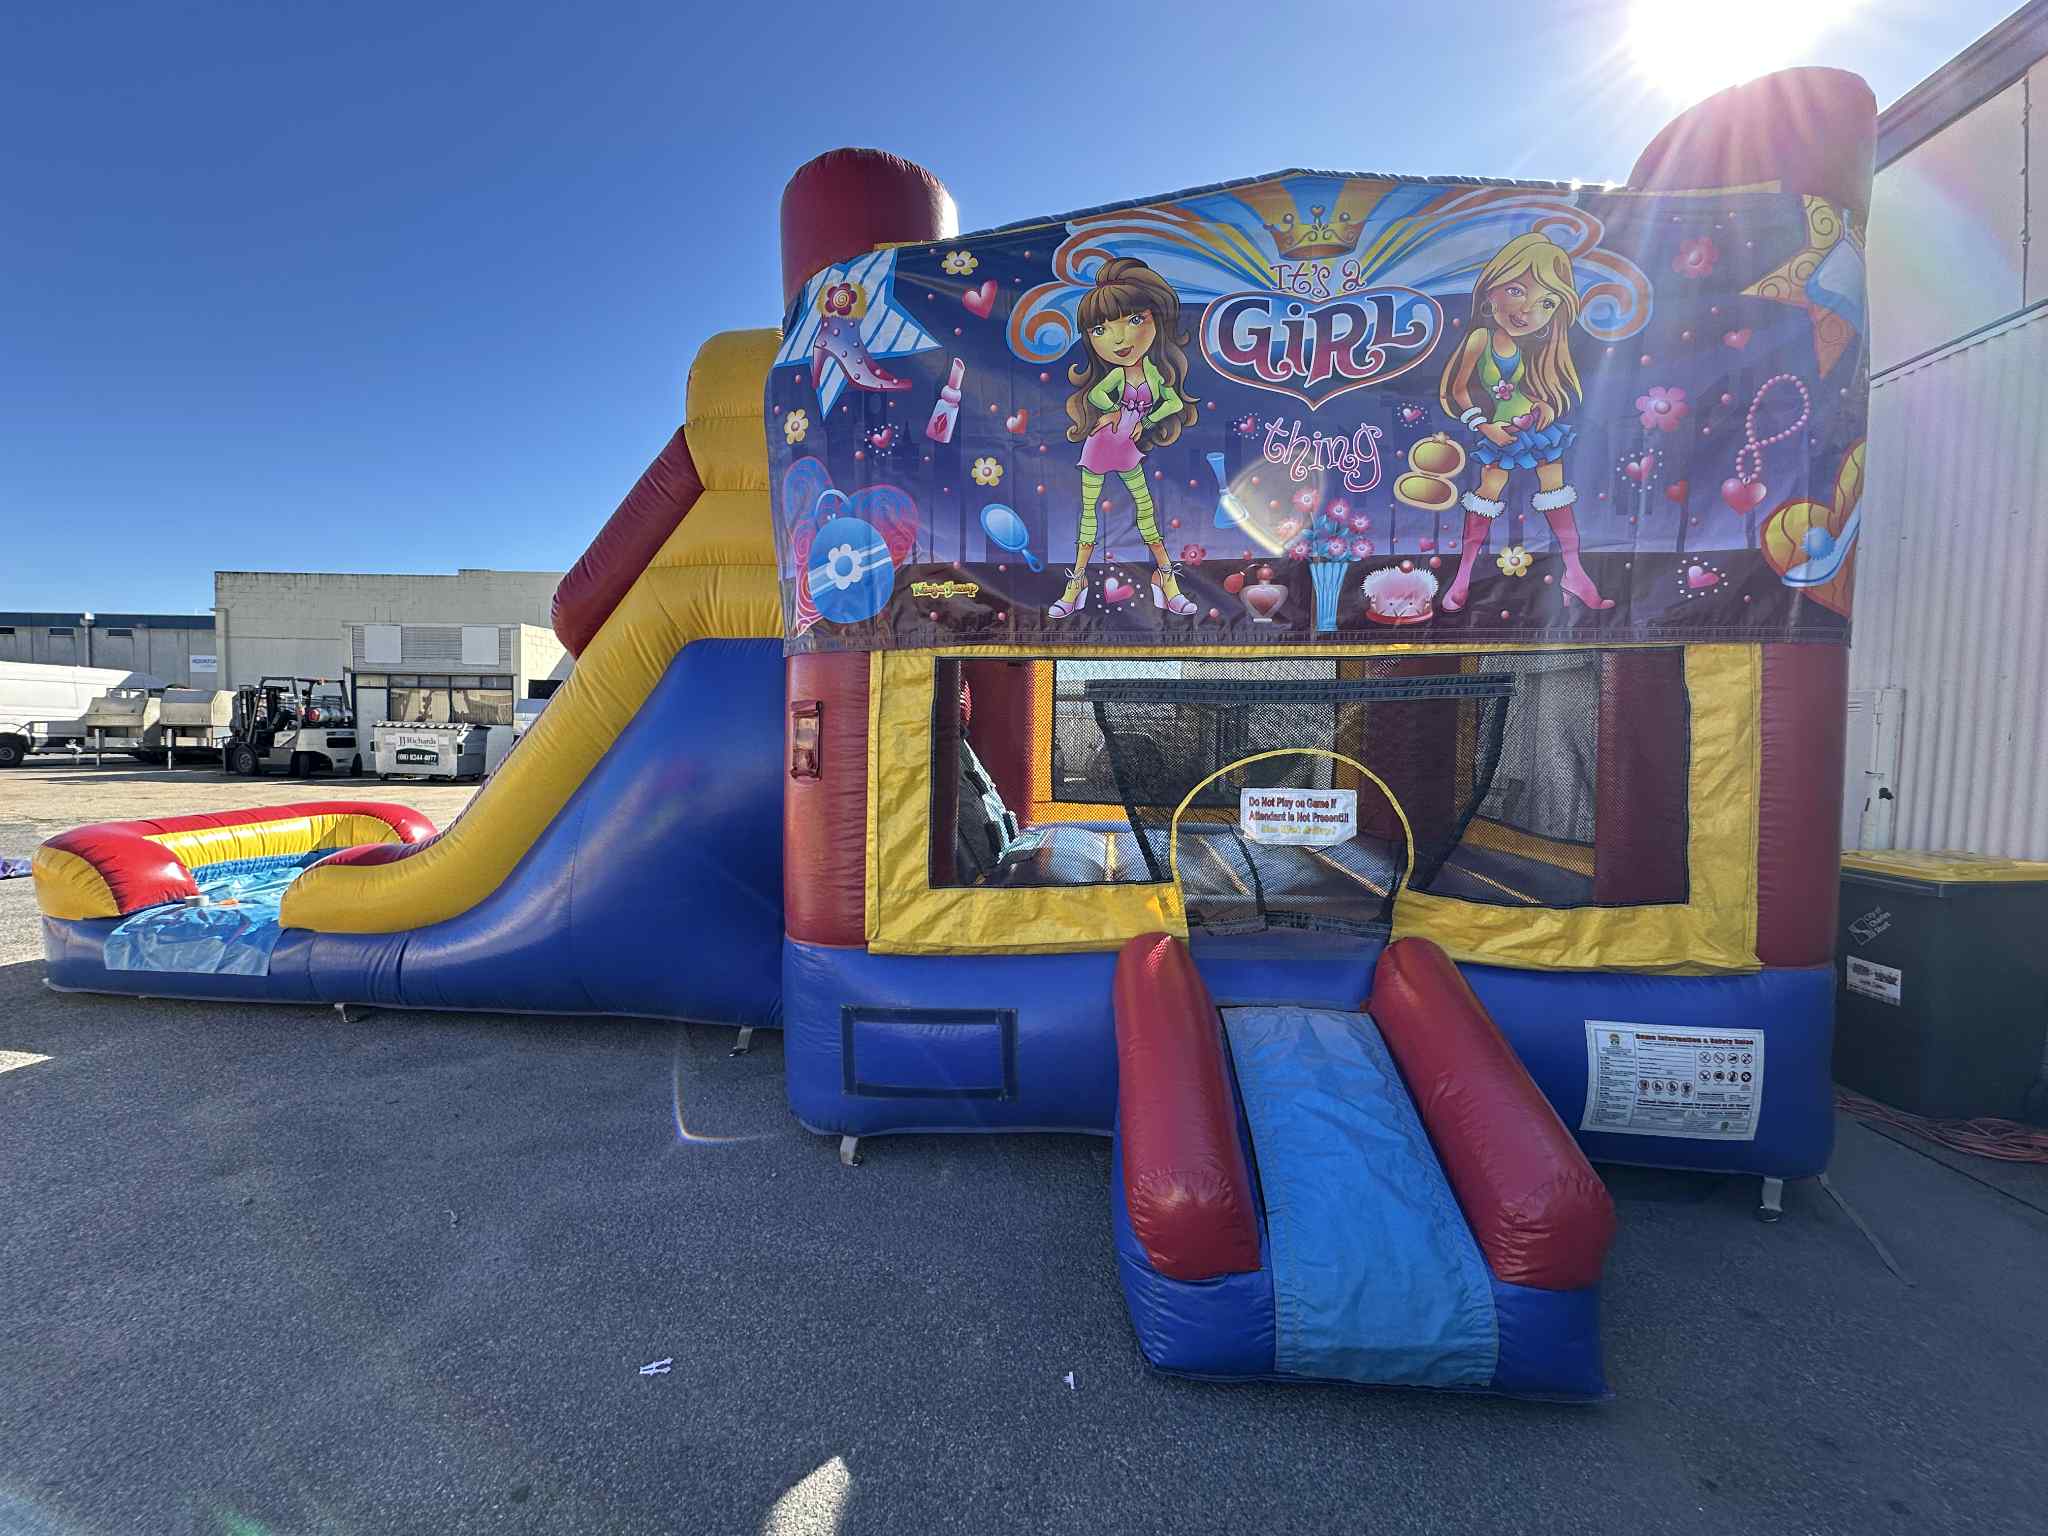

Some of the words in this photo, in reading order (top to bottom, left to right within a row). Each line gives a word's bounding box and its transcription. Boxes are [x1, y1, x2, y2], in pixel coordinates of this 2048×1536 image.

[1270, 262, 1331, 299] It's
[1342, 258, 1366, 291] a
[1263, 417, 1384, 493] thing
[1248, 797, 1259, 807] Do
[1262, 797, 1275, 808] Not
[1277, 797, 1293, 809] Play
[1295, 799, 1305, 809] on
[1306, 798, 1329, 809] Game
[1248, 811, 1286, 822] Attendant
[1297, 812, 1310, 822] Not
